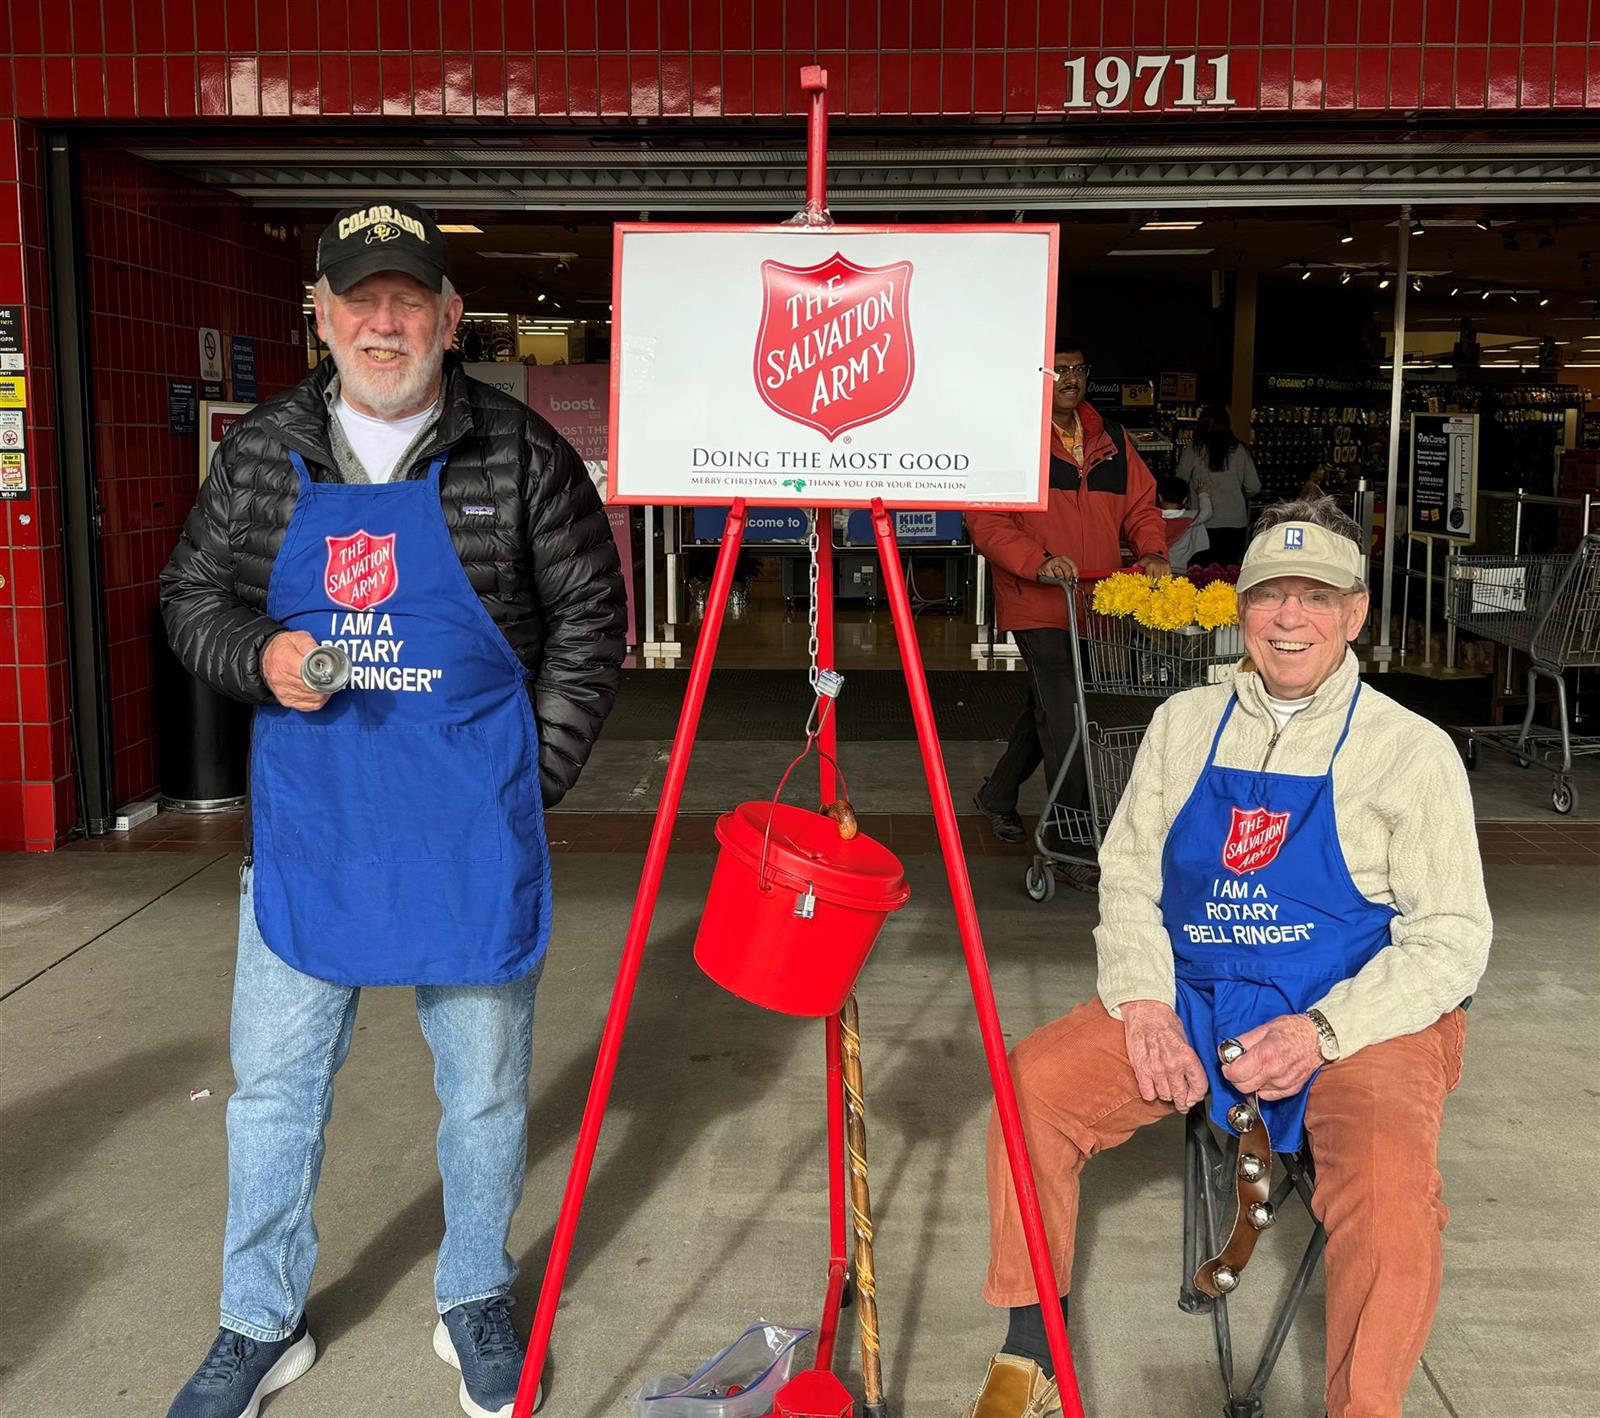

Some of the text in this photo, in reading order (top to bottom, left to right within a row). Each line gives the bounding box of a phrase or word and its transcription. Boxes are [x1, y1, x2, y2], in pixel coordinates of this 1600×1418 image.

[1063, 54, 1236, 107] 19711
[339, 205, 426, 241] COLORADO
[786, 274, 846, 330] THE
[766, 280, 895, 389] SALVATION
[811, 332, 892, 415] ARMY
[1276, 379, 1306, 388] ORGANIC
[1088, 382, 1120, 393] Donuts
[550, 396, 595, 411] boost
[693, 448, 969, 471] DOING THE MOST GOOD
[691, 477, 722, 485] MERRY
[724, 477, 777, 486] CHRISTMAS
[809, 479, 841, 487] THANK
[843, 480, 863, 488] YOU
[866, 480, 884, 488] FOR
[915, 481, 966, 489] DONATION
[746, 517, 800, 528] lcome to
[898, 525, 934, 536] Soopers
[899, 514, 933, 525] KING
[339, 538, 367, 565] THE
[329, 542, 390, 593] SALVATION
[351, 565, 388, 603] ARMY
[331, 613, 394, 636] I AM A
[1239, 815, 1264, 836] THE
[1227, 819, 1283, 859] SALVATION
[1238, 841, 1278, 869] ARMY
[1213, 879, 1268, 899] I AM A
[1205, 902, 1279, 921] ROTARY
